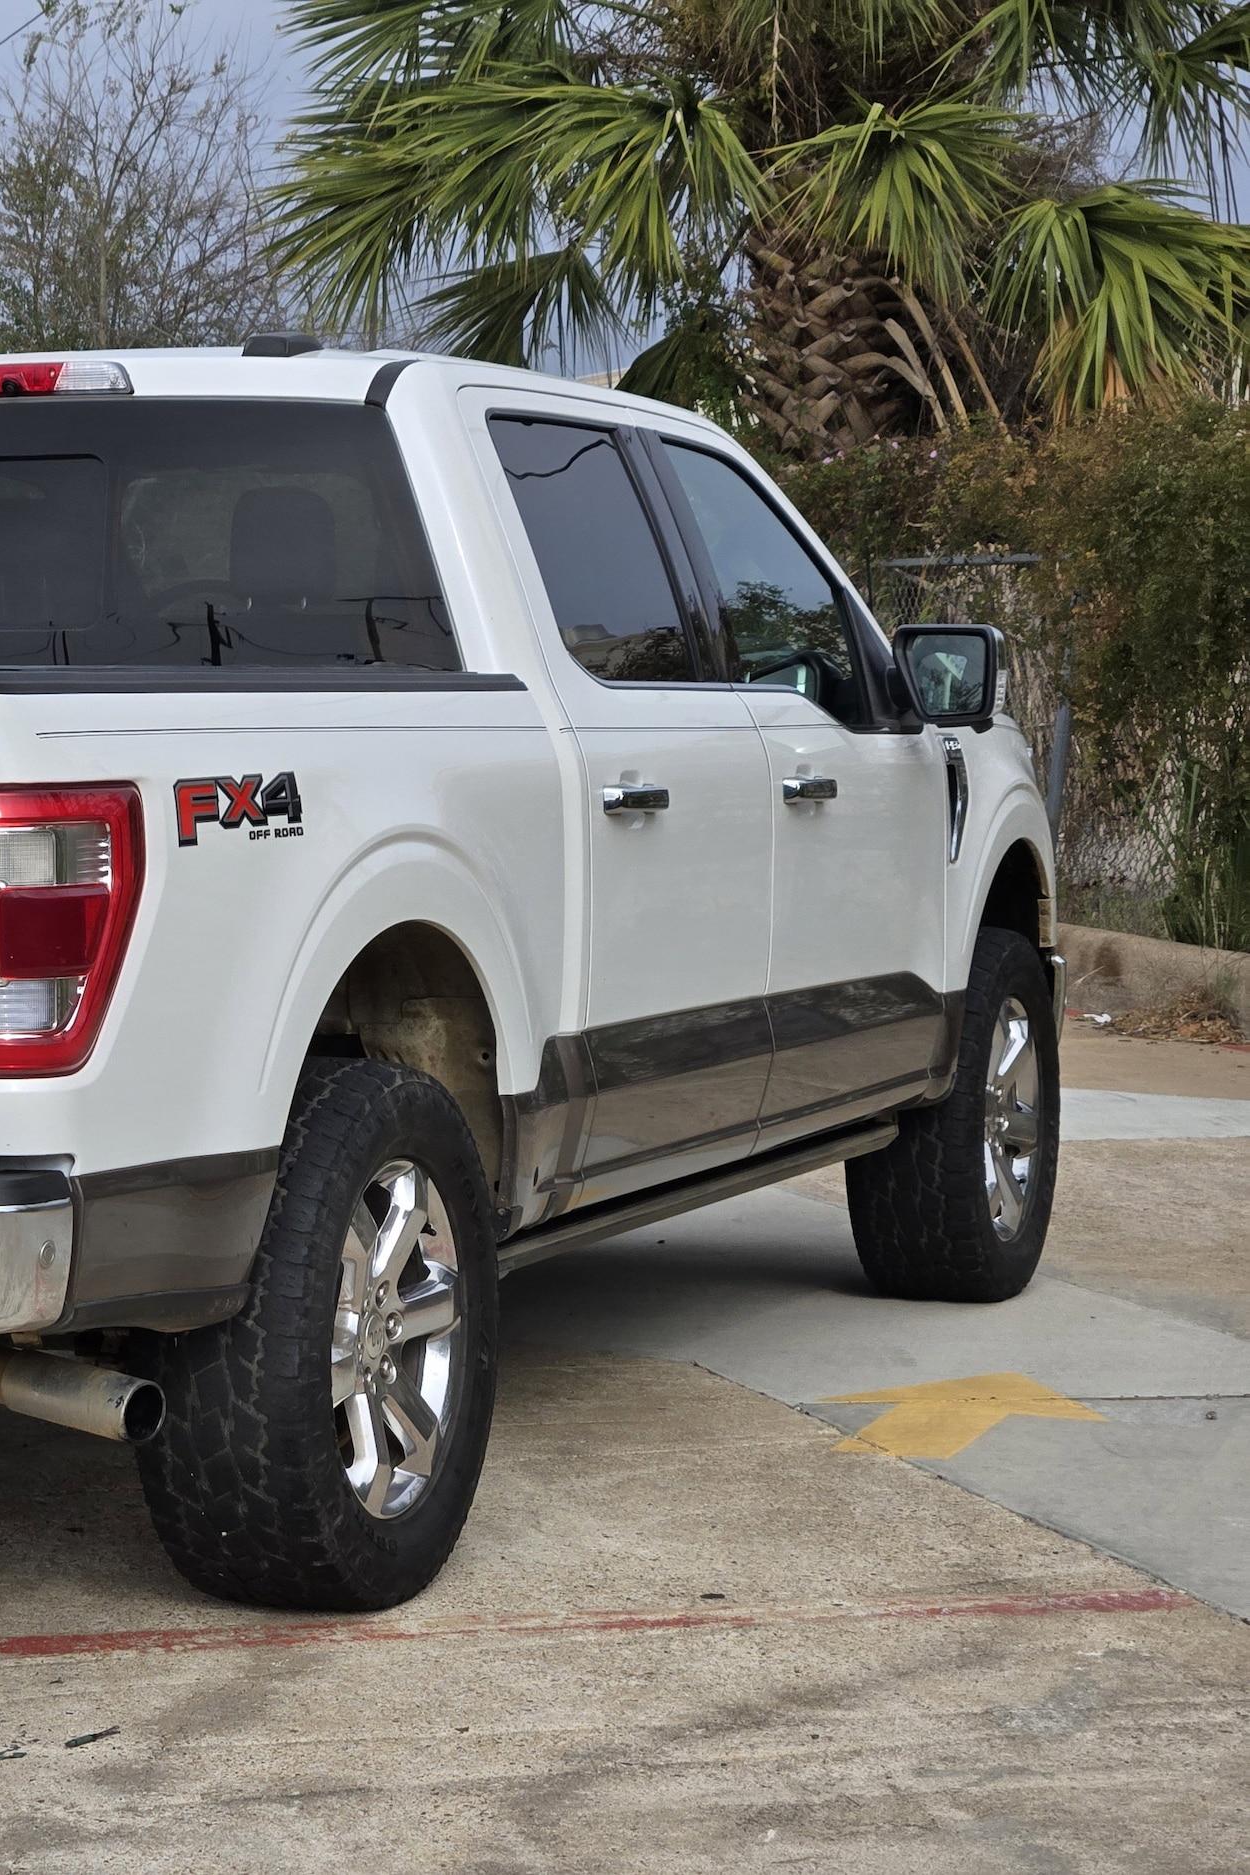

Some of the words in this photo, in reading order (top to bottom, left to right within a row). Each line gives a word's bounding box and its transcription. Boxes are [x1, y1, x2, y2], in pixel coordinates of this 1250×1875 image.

[173, 771, 302, 847] FX4
[249, 829, 271, 840] OFF
[274, 826, 304, 838] ROAD
